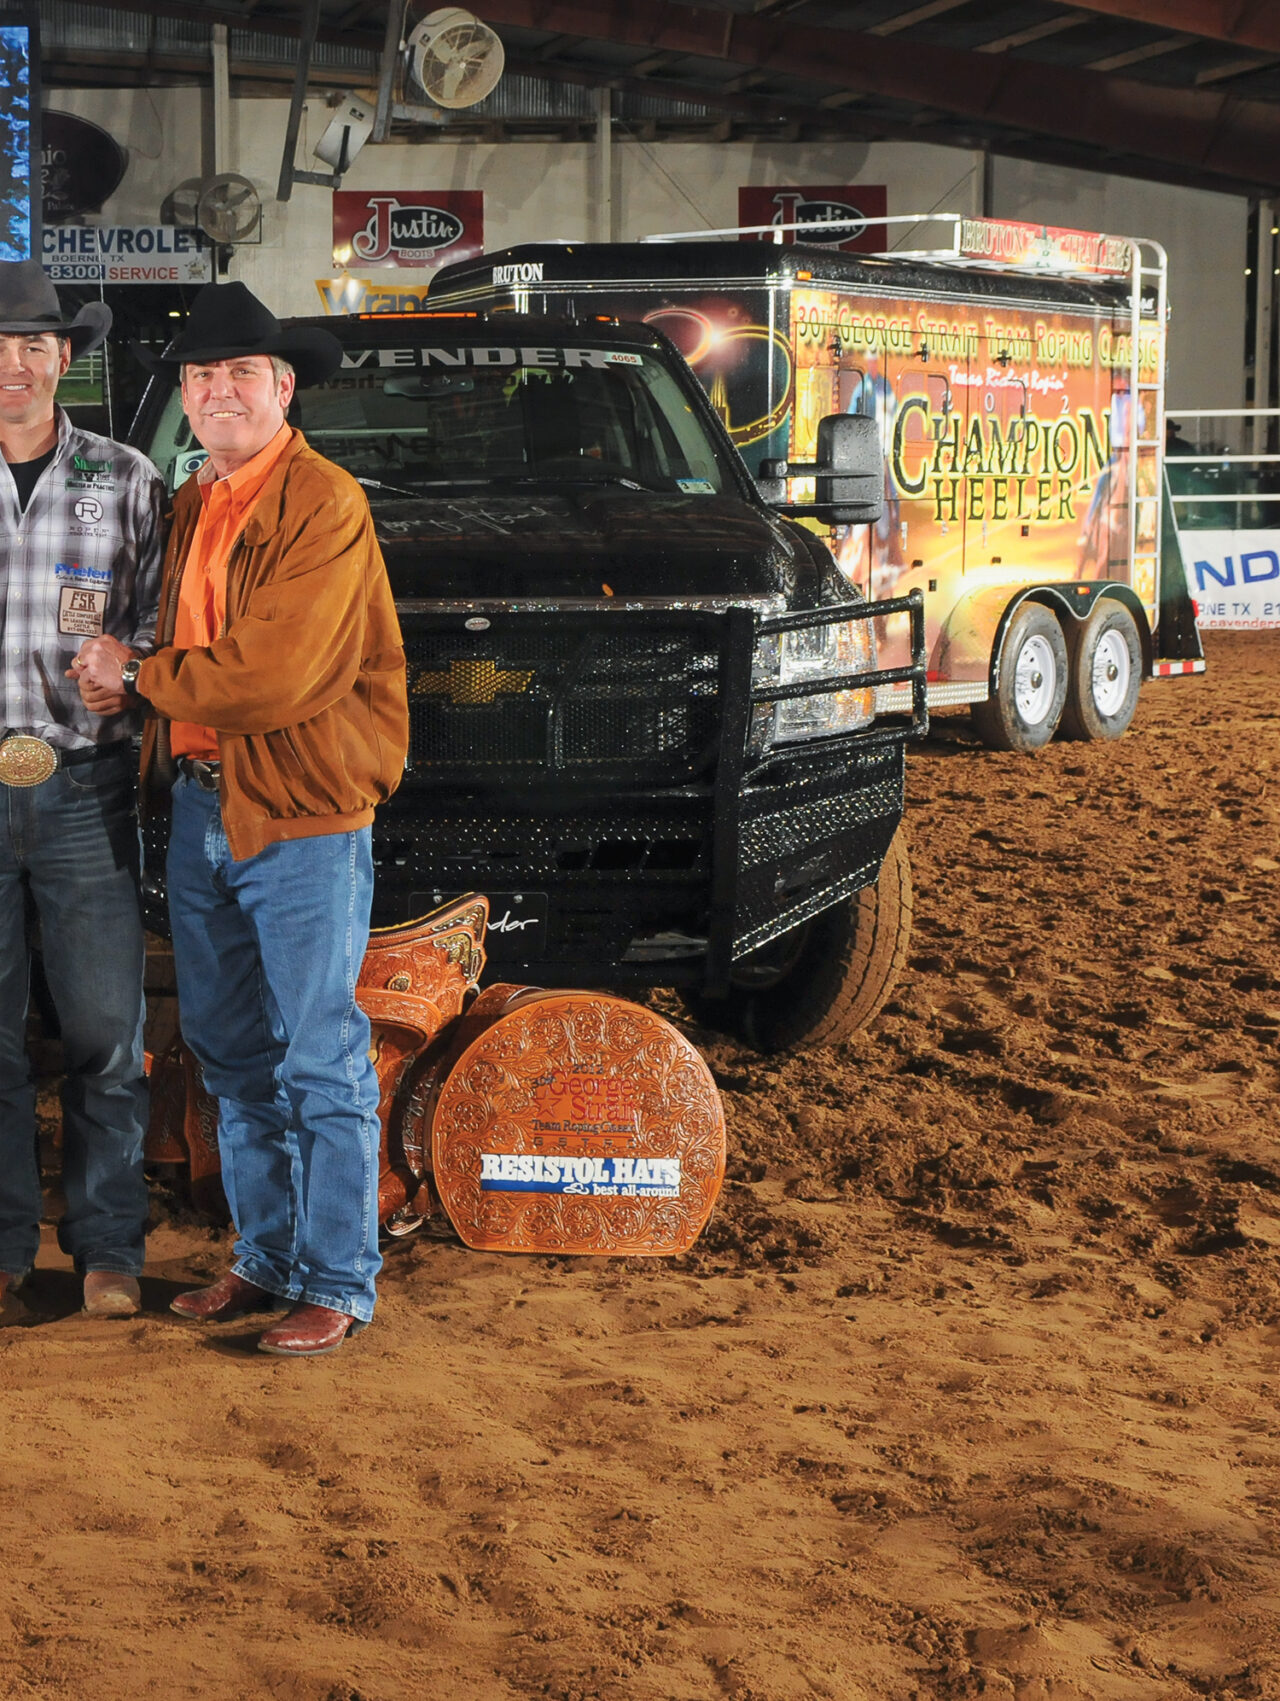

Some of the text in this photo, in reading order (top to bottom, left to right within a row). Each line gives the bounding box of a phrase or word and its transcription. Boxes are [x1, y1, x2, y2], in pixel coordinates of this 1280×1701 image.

[352, 198, 454, 260] Justin
[110, 254, 125, 262] TX
[400, 249, 434, 258] BOOTS
[109, 267, 179, 280] SERVICE
[493, 263, 544, 285] BRUTON
[322, 287, 429, 316] Wran
[893, 397, 1111, 494] CHAMPION
[934, 478, 1075, 521] HEELER
[1232, 603, 1251, 615] TX
[550, 1070, 634, 1104] George
[571, 1095, 638, 1122] Strait
[532, 1119, 561, 1132] Team
[480, 1154, 681, 1185] RESISTOL HATS
[592, 1184, 681, 1198] best all-around
